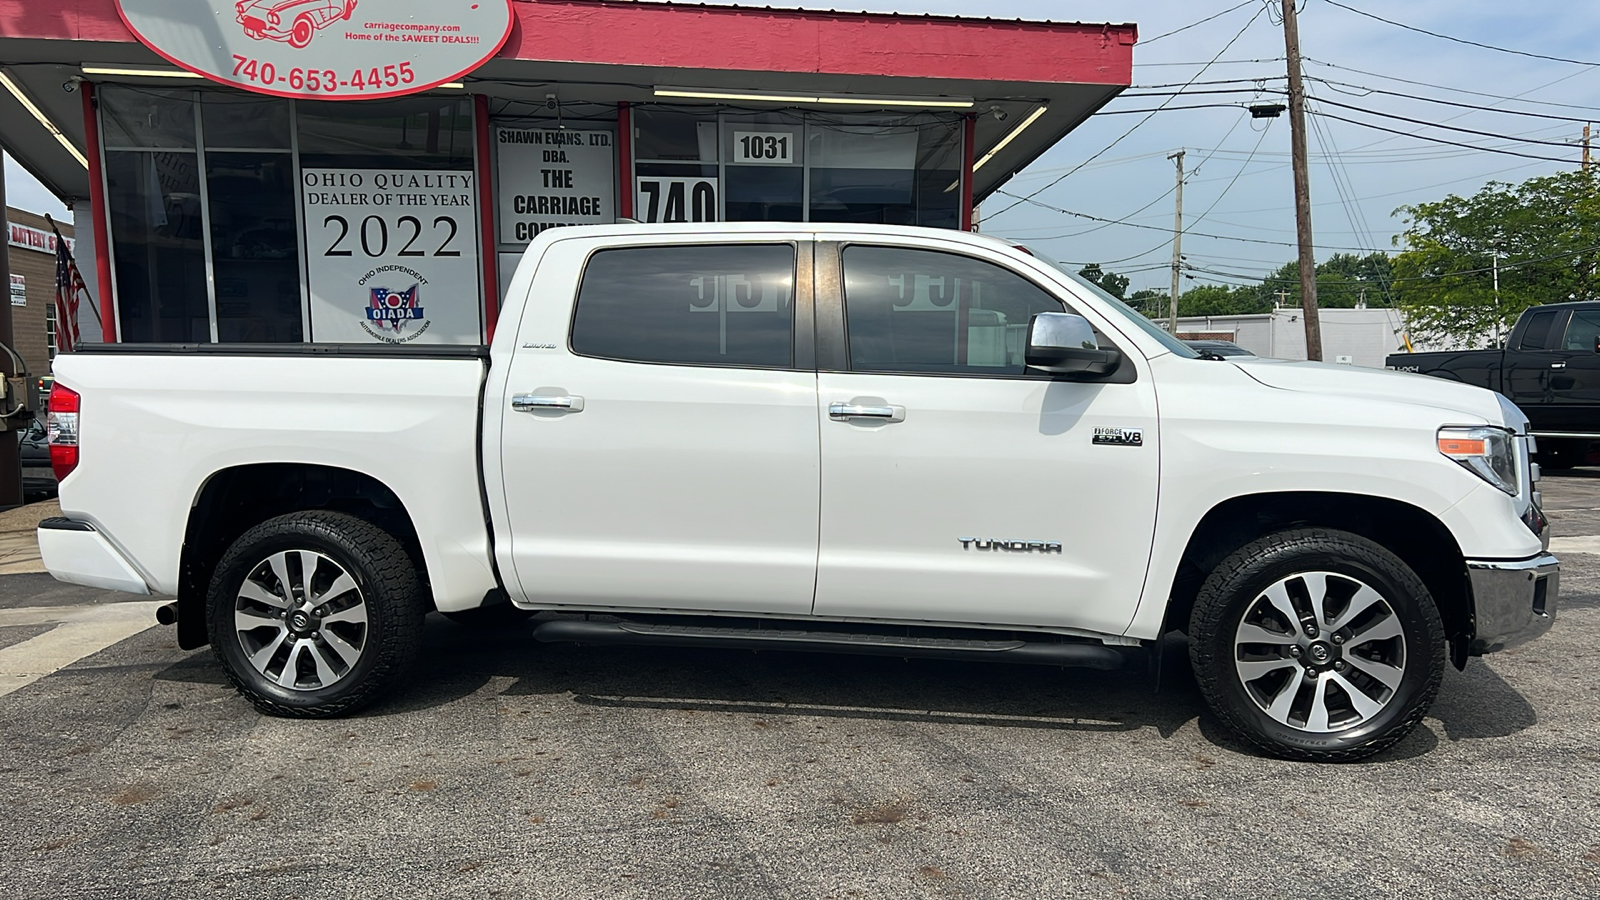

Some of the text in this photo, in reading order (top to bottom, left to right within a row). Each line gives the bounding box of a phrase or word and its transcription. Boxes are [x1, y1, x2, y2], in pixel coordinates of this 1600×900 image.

[364, 22, 460, 33] carriagecompany.com
[345, 32, 479, 44] Home of the SAWEET DEALS!!!
[232, 54, 415, 92] 740-653-4455
[499, 130, 543, 144] SHAWN
[589, 133, 611, 147] LTD.
[740, 135, 788, 159] 1031
[543, 150, 570, 163] DBA.
[304, 173, 472, 190] OHIO QUALITY
[541, 169, 573, 188] THE
[308, 193, 471, 206] DEALER OF THE YEAR
[513, 195, 601, 215] CARRIAGE
[640, 181, 716, 223] 740
[323, 214, 461, 258] 2022
[358, 265, 429, 286] OHIO INDEPENDENT
[373, 308, 415, 319] OIADA
[359, 321, 385, 341] AUTOMOBILE
[406, 319, 431, 341] ASSOCIATION
[1123, 432, 1141, 443] V8
[957, 537, 1062, 554] TUNDRA
